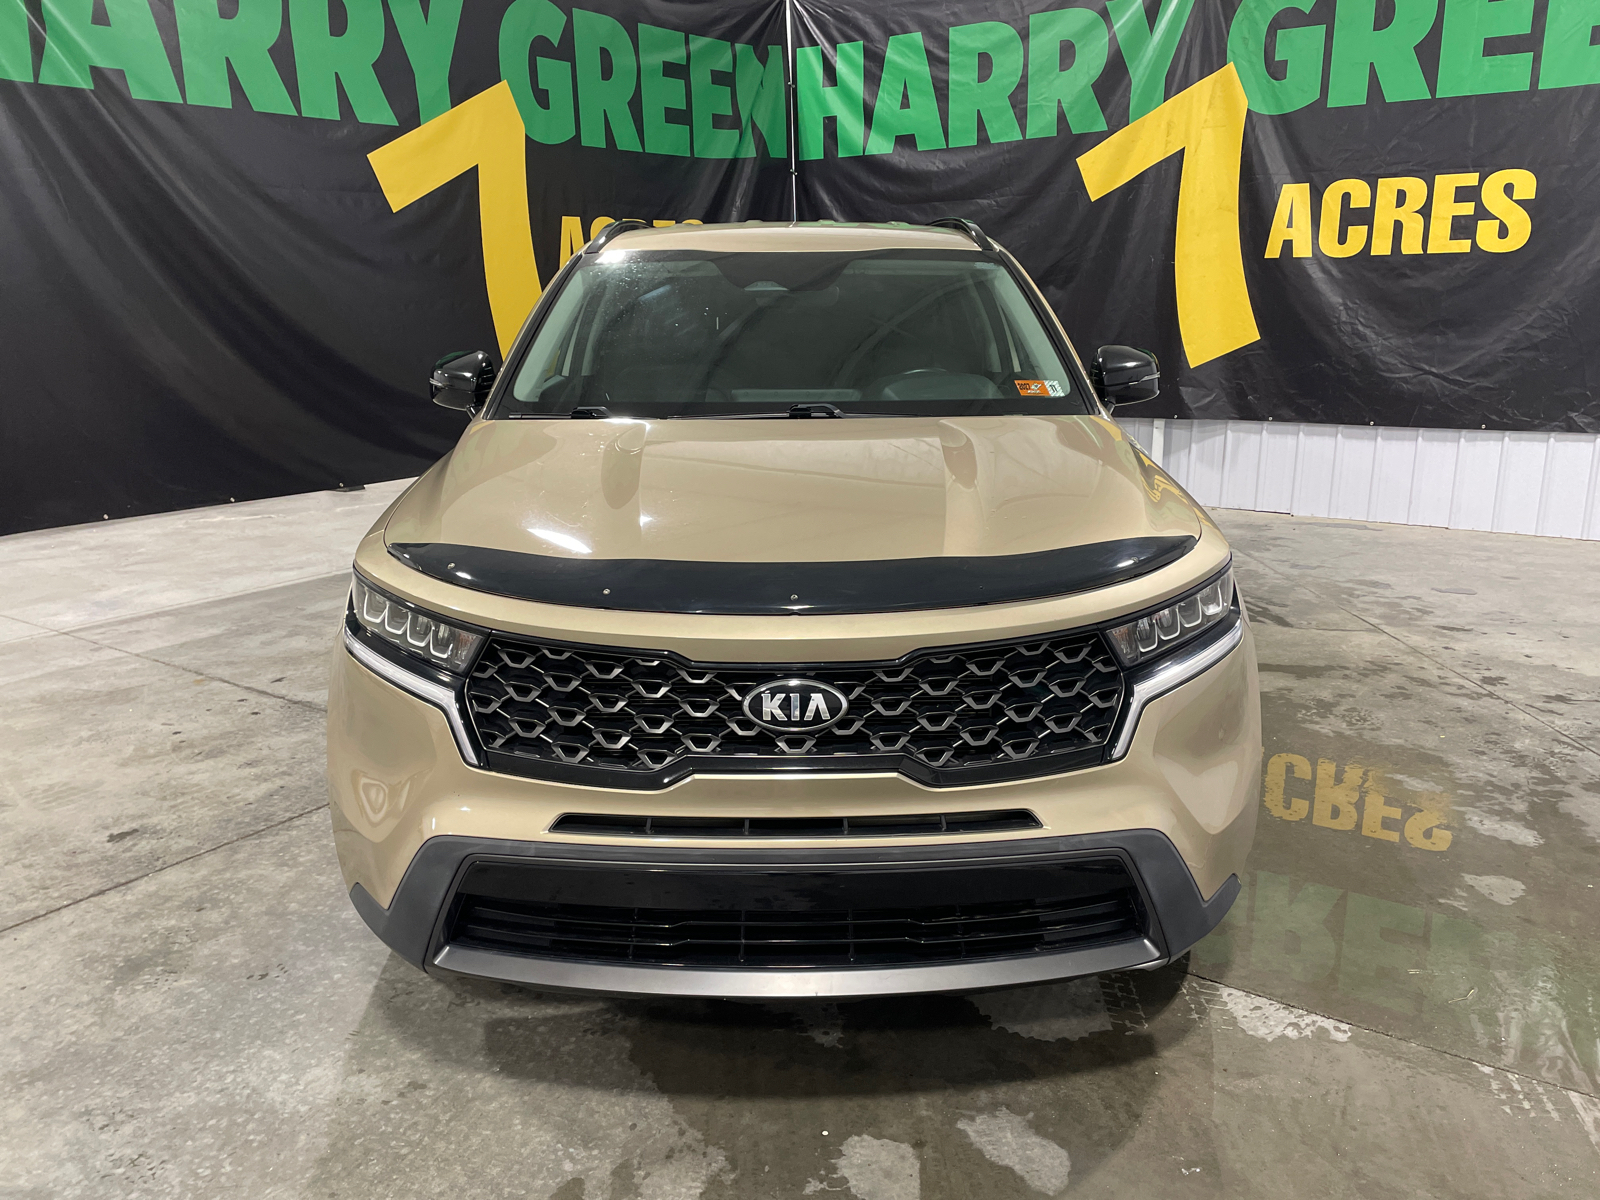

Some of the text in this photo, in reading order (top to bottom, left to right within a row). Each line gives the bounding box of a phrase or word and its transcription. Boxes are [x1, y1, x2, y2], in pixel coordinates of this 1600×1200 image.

[498, 0, 788, 159] GREEN
[796, 0, 1195, 161] HARRY
[366, 79, 544, 362] 7
[1075, 61, 1537, 369] 7 ACRES
[761, 693, 831, 721] KIA
